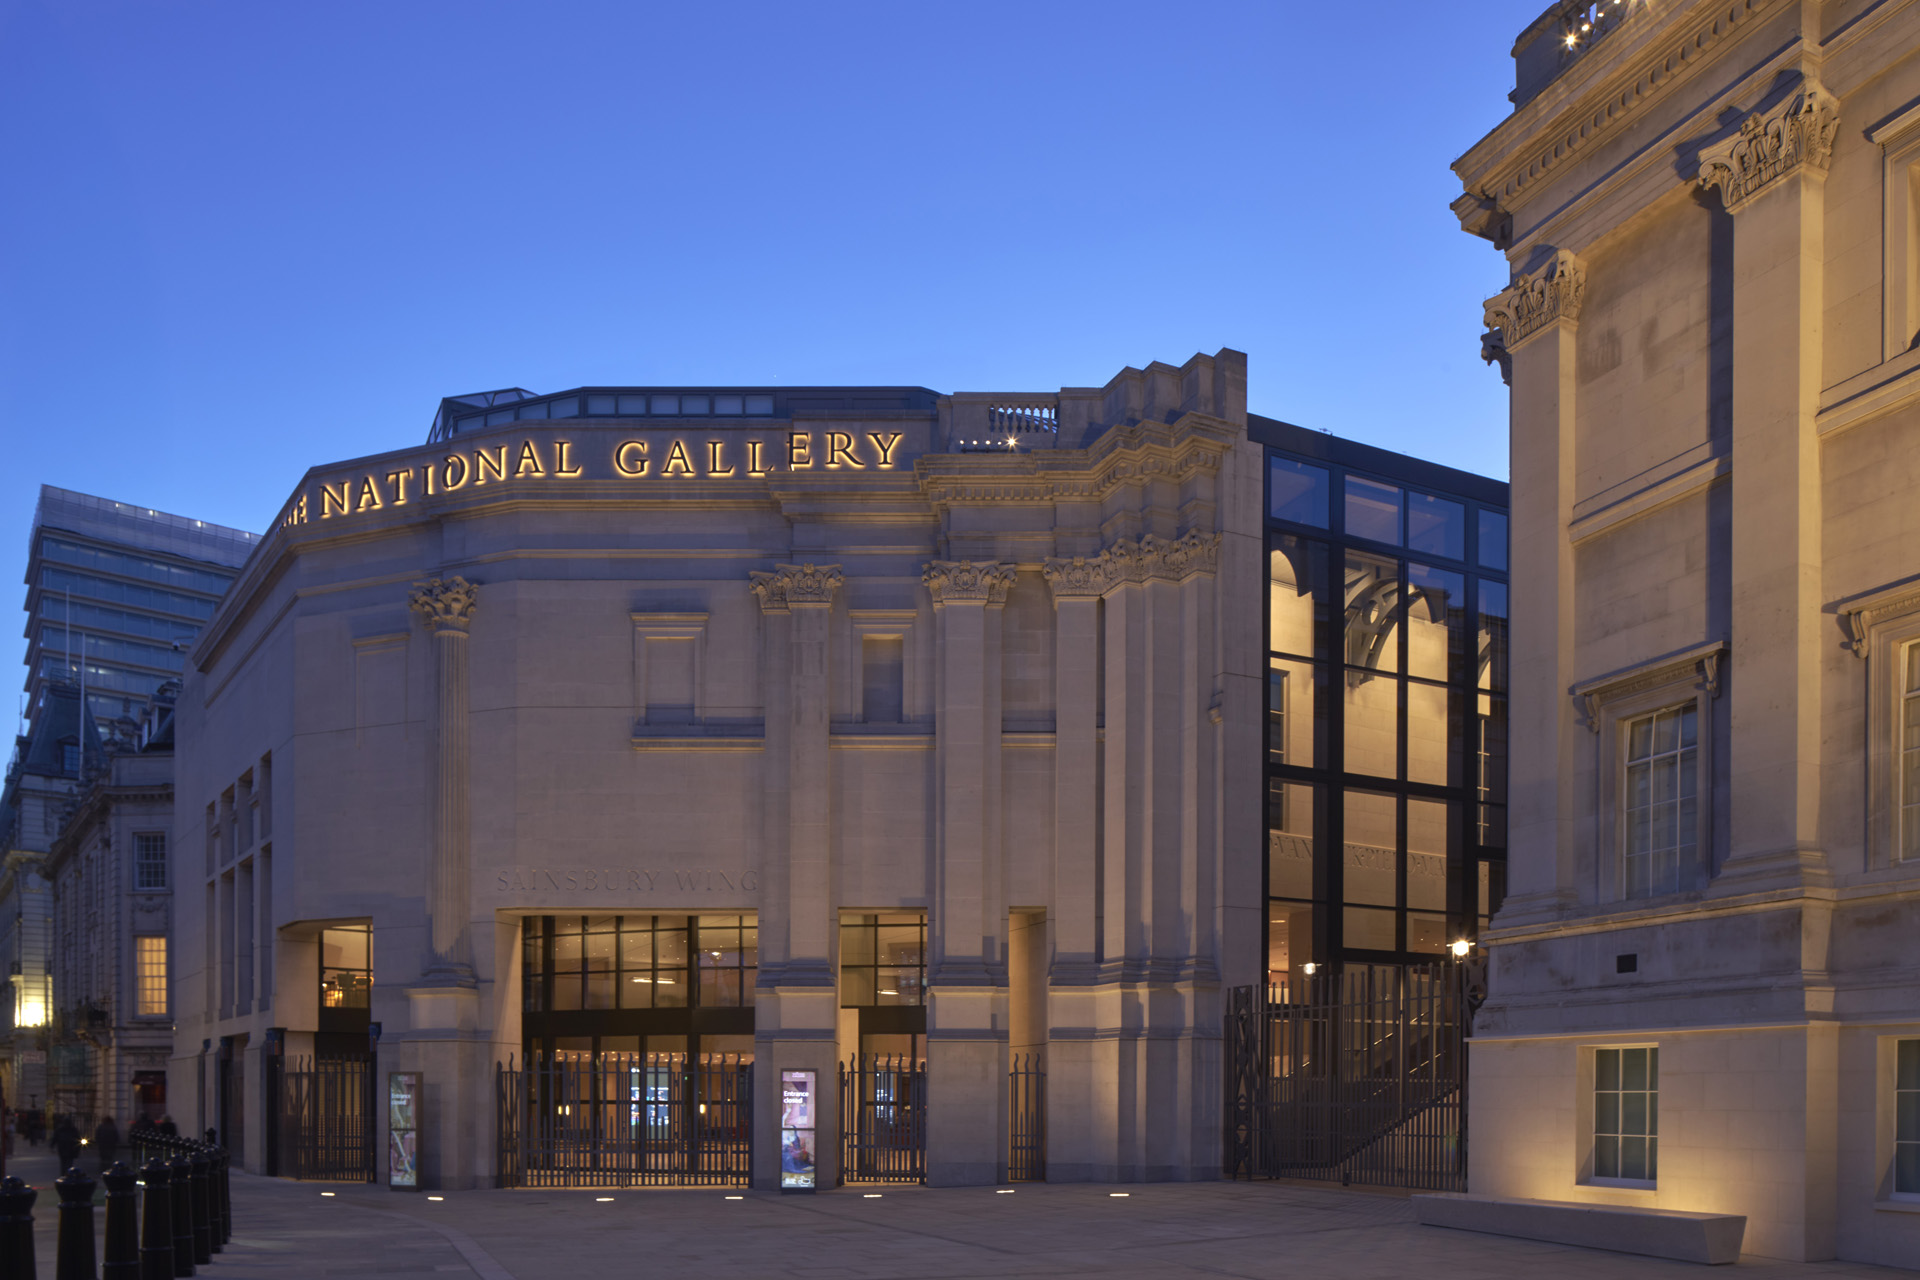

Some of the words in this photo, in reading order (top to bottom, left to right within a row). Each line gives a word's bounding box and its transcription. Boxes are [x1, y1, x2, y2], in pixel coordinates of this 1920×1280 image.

[318, 440, 582, 518] NATIONAL
[614, 431, 903, 477] GALLERY
[496, 868, 662, 892] SAINSBURY
[674, 868, 760, 892] WING
